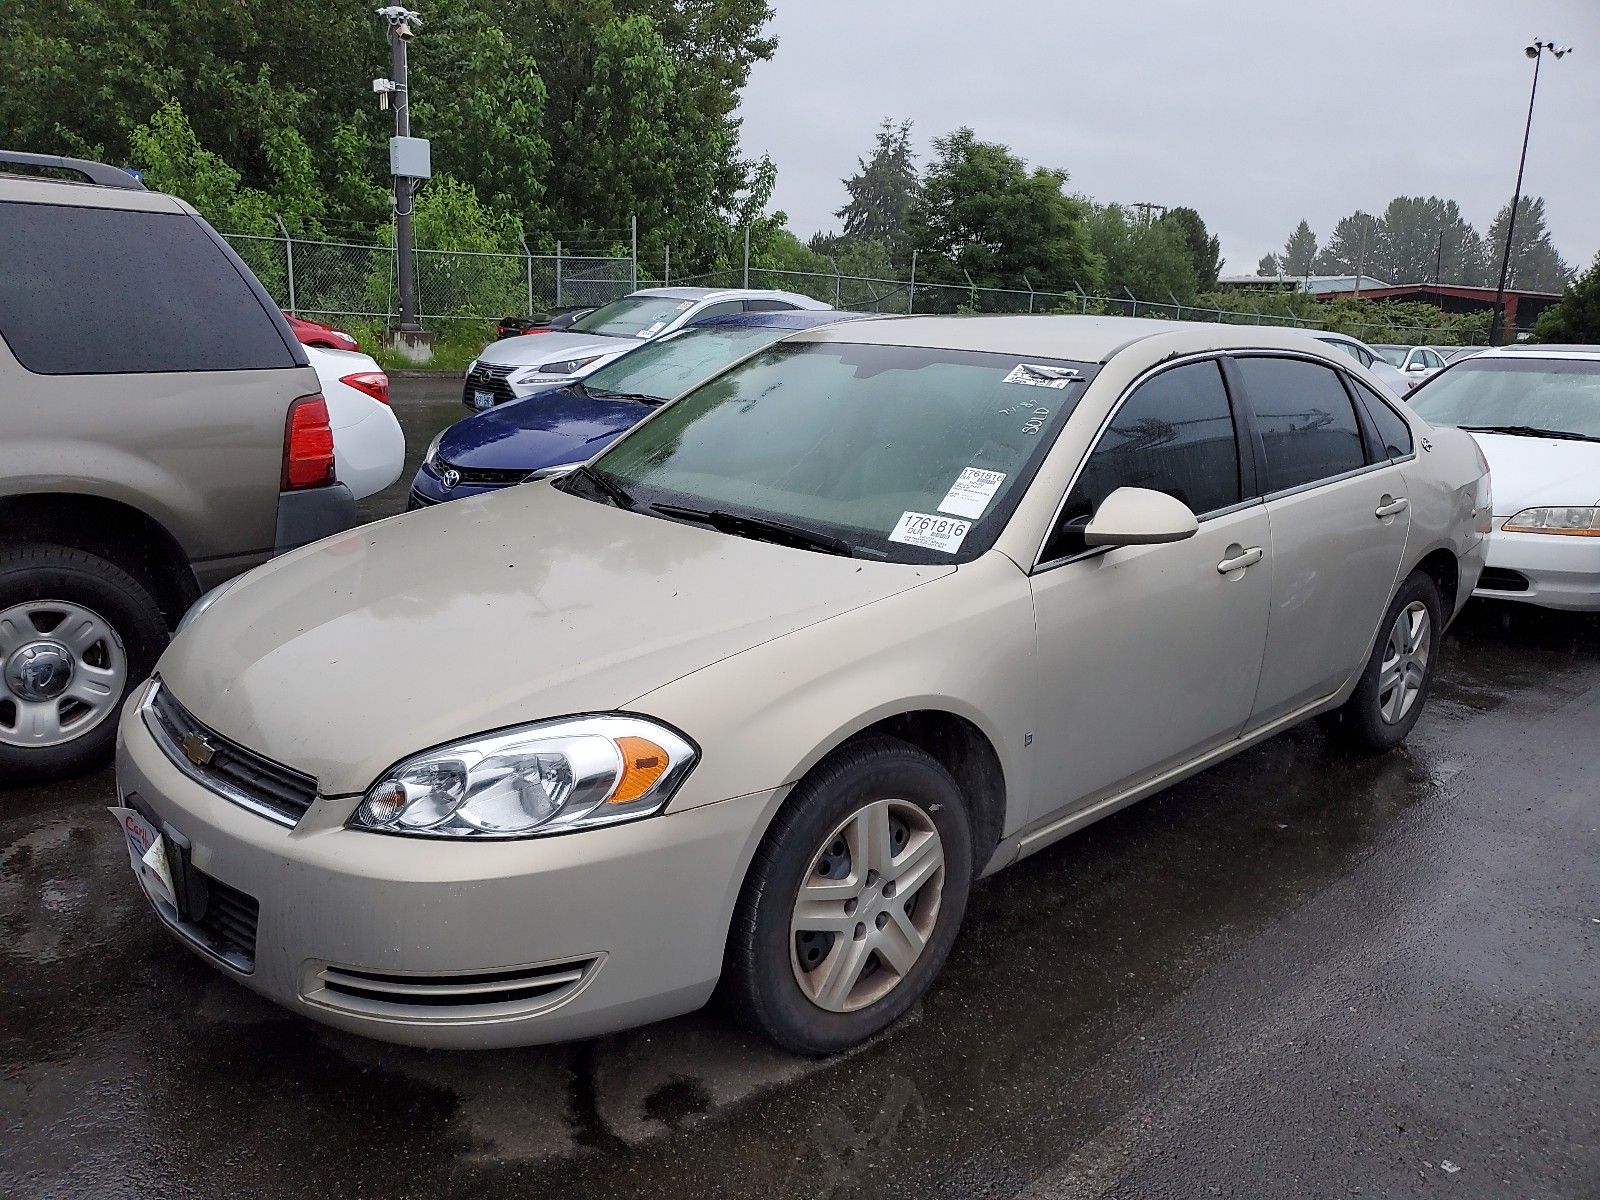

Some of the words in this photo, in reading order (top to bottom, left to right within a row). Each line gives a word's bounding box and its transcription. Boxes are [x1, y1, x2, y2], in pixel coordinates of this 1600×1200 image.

[1022, 407, 1049, 435] SOLD
[905, 514, 966, 537] 1761816
[907, 527, 924, 536] DLR
